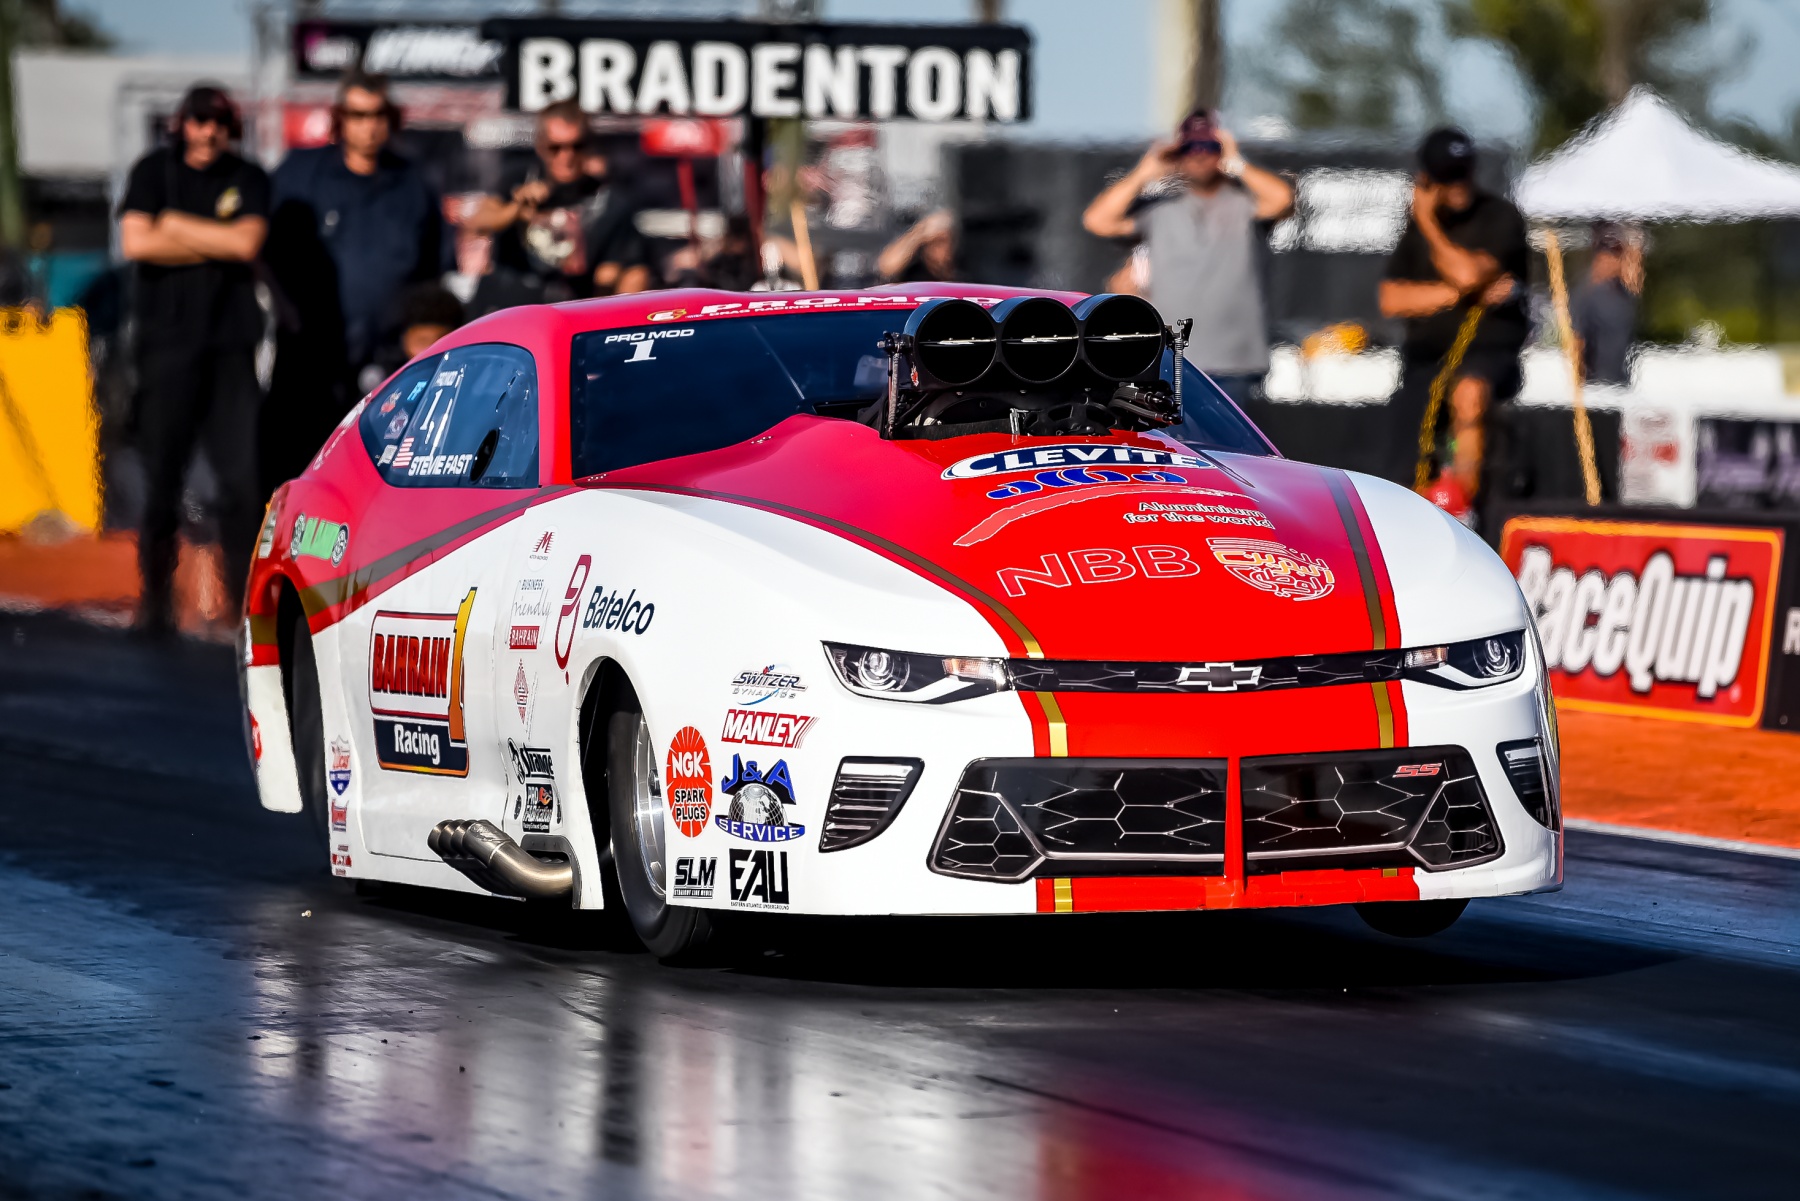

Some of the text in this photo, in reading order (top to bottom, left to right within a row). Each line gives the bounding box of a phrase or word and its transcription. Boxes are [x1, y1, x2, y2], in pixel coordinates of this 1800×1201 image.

[518, 37, 1020, 121] BRADENTON
[700, 297, 841, 314] PRO
[709, 309, 751, 317] DRAG
[755, 304, 810, 312] RACING
[604, 328, 695, 344] PRO MOD
[624, 339, 657, 363] 1
[408, 455, 447, 476] STEVIE
[445, 453, 473, 475] FAST
[951, 448, 1198, 478] CLEVITE
[1123, 511, 1276, 530] for the world
[1138, 502, 1267, 519] Aluminium
[996, 545, 1201, 598] NBB
[583, 586, 655, 635] Batelco
[510, 629, 538, 646] BAHRAIN
[373, 633, 451, 698] BAHRAIN
[448, 587, 478, 744] 1
[732, 671, 806, 692] SWITZER
[732, 687, 797, 699] DYNAMICS
[722, 710, 806, 746] MANLEY
[394, 723, 441, 765] Racing
[520, 744, 554, 777] Strange
[672, 751, 704, 779] NGK
[1392, 762, 1442, 778] SS
[721, 752, 797, 806] J&A
[674, 787, 706, 804] SPARK
[675, 805, 706, 822] PLUGS
[718, 818, 801, 842] SERVICE
[674, 857, 717, 888] SLM
[729, 848, 789, 905] EAU
